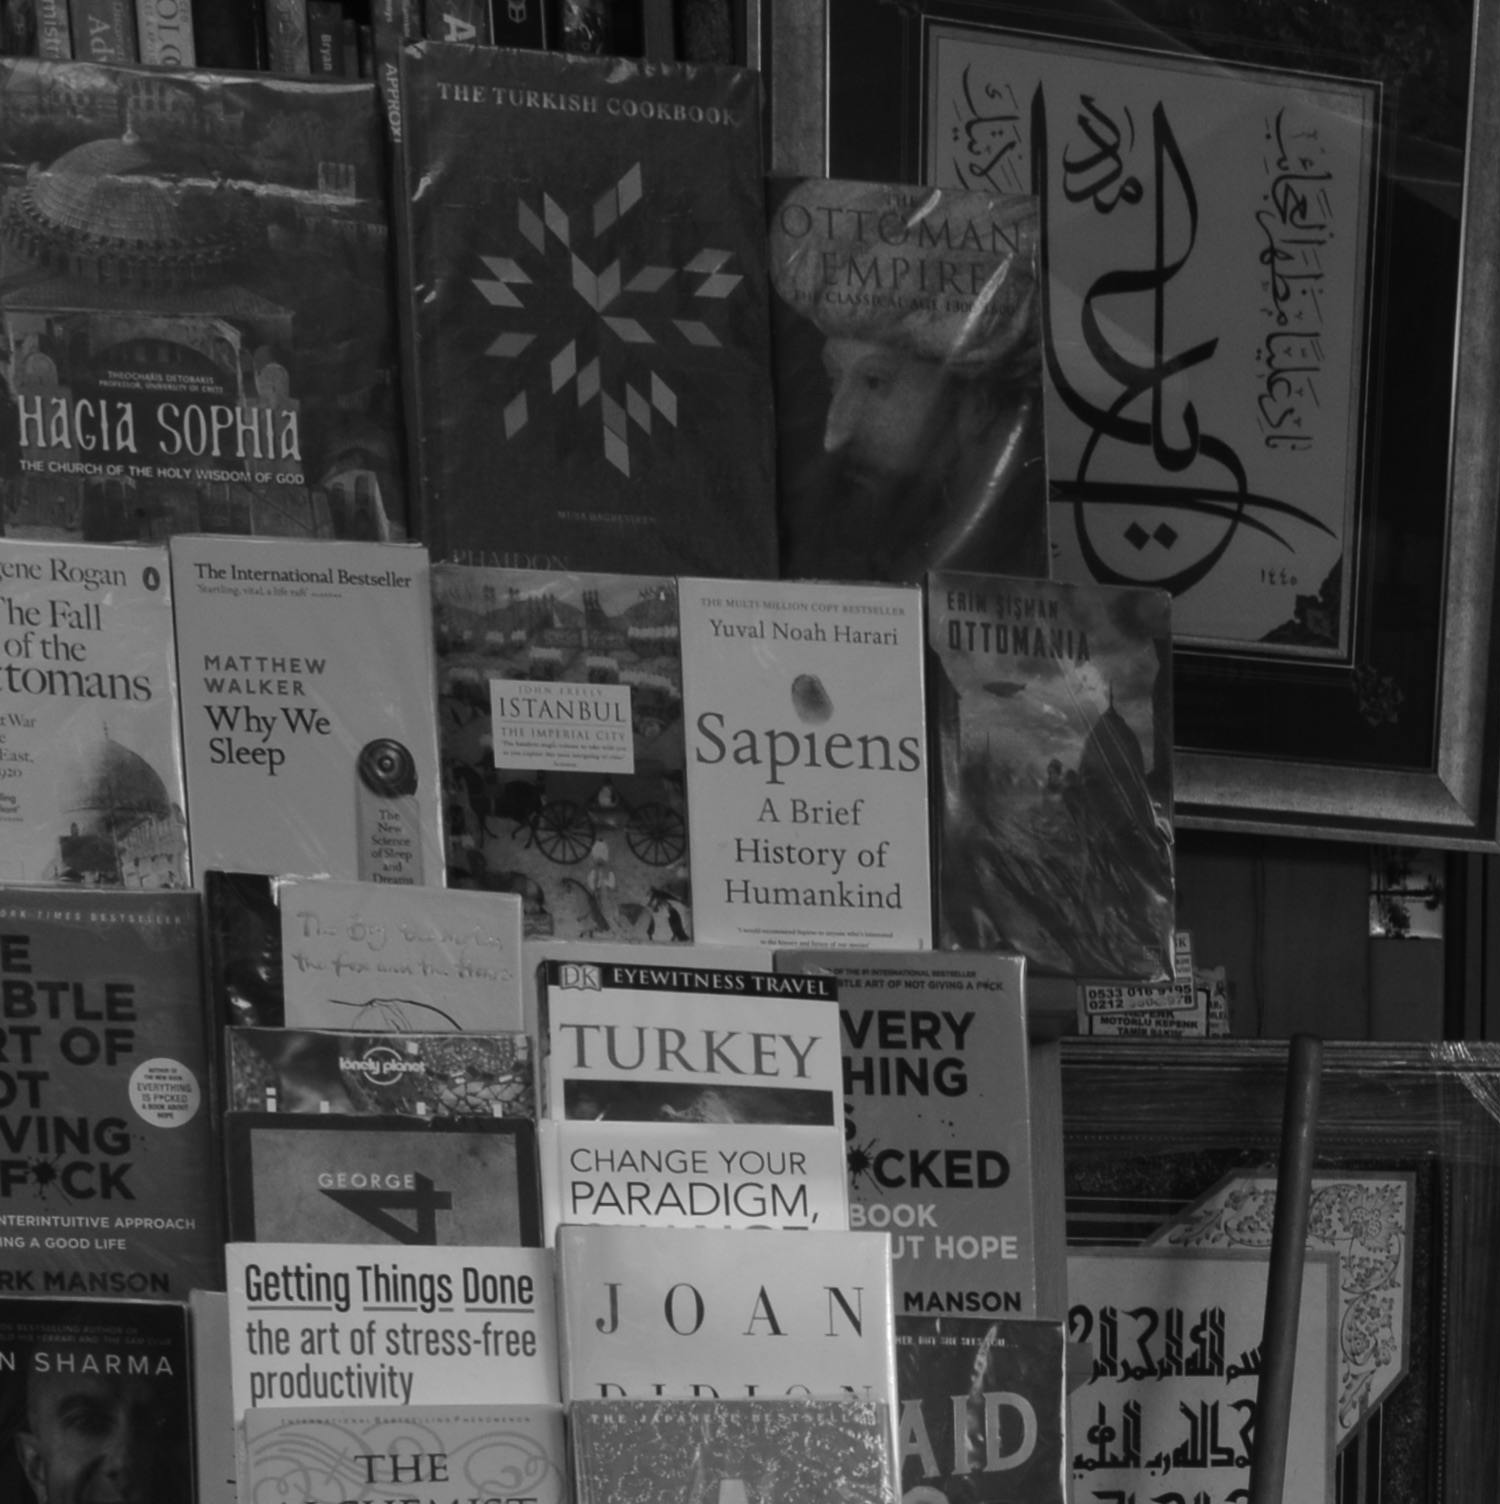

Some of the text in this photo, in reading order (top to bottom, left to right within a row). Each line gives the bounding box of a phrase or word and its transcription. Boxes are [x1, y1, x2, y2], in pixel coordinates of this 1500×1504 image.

[436, 82, 738, 127] THE TURKISH COOKBOOK
[780, 204, 1022, 255] OTTOMAN
[822, 251, 986, 296] EMPIRE
[156, 402, 303, 462] SOPHIA
[19, 458, 305, 486] THE CHURCH OF THE HOLY WISDOM OF GOD
[50, 558, 127, 592] Rogan
[195, 563, 411, 589] The International Bestseller
[50, 600, 102, 632] Fall
[4, 631, 87, 662] of the
[710, 619, 899, 645] Yuval Noah Harari
[948, 620, 1091, 661] OTTOMANIA
[203, 655, 328, 676] MATTHEW
[0, 664, 153, 703] tomans
[204, 678, 307, 697] WALKER
[204, 705, 332, 742] Why We
[498, 696, 627, 723] ISTANBUL
[531, 728, 626, 743] IMPERIAL CITY
[695, 711, 921, 785] Sapiens
[209, 738, 287, 776] Sleep
[756, 798, 865, 826] A Brief
[734, 838, 891, 875] History of
[723, 879, 904, 910] Humankind
[560, 964, 600, 990] DK
[612, 967, 831, 997] EYEWITNESS TRAVEL
[59, 1026, 135, 1066] OF
[560, 1023, 823, 1079] TURKEY
[340, 1057, 378, 1074] lonely
[569, 1148, 808, 1175] CHANGE YOUR
[318, 1171, 415, 1191] GEORGE
[570, 1180, 820, 1225] PARADIGM,
[114, 1216, 197, 1231] APPROACH
[45, 1236, 128, 1250] GOOD LIFE
[934, 1235, 1020, 1261] HOPE
[44, 1271, 170, 1294] MANSON
[245, 1264, 535, 1313] Getting Things Done
[594, 1282, 865, 1338] JOAN
[903, 1290, 1021, 1314] MANSON
[247, 1320, 537, 1357] the art of stress-free
[34, 1352, 174, 1376] SHARMA
[251, 1363, 414, 1407] productivity
[354, 1453, 450, 1484] THE
